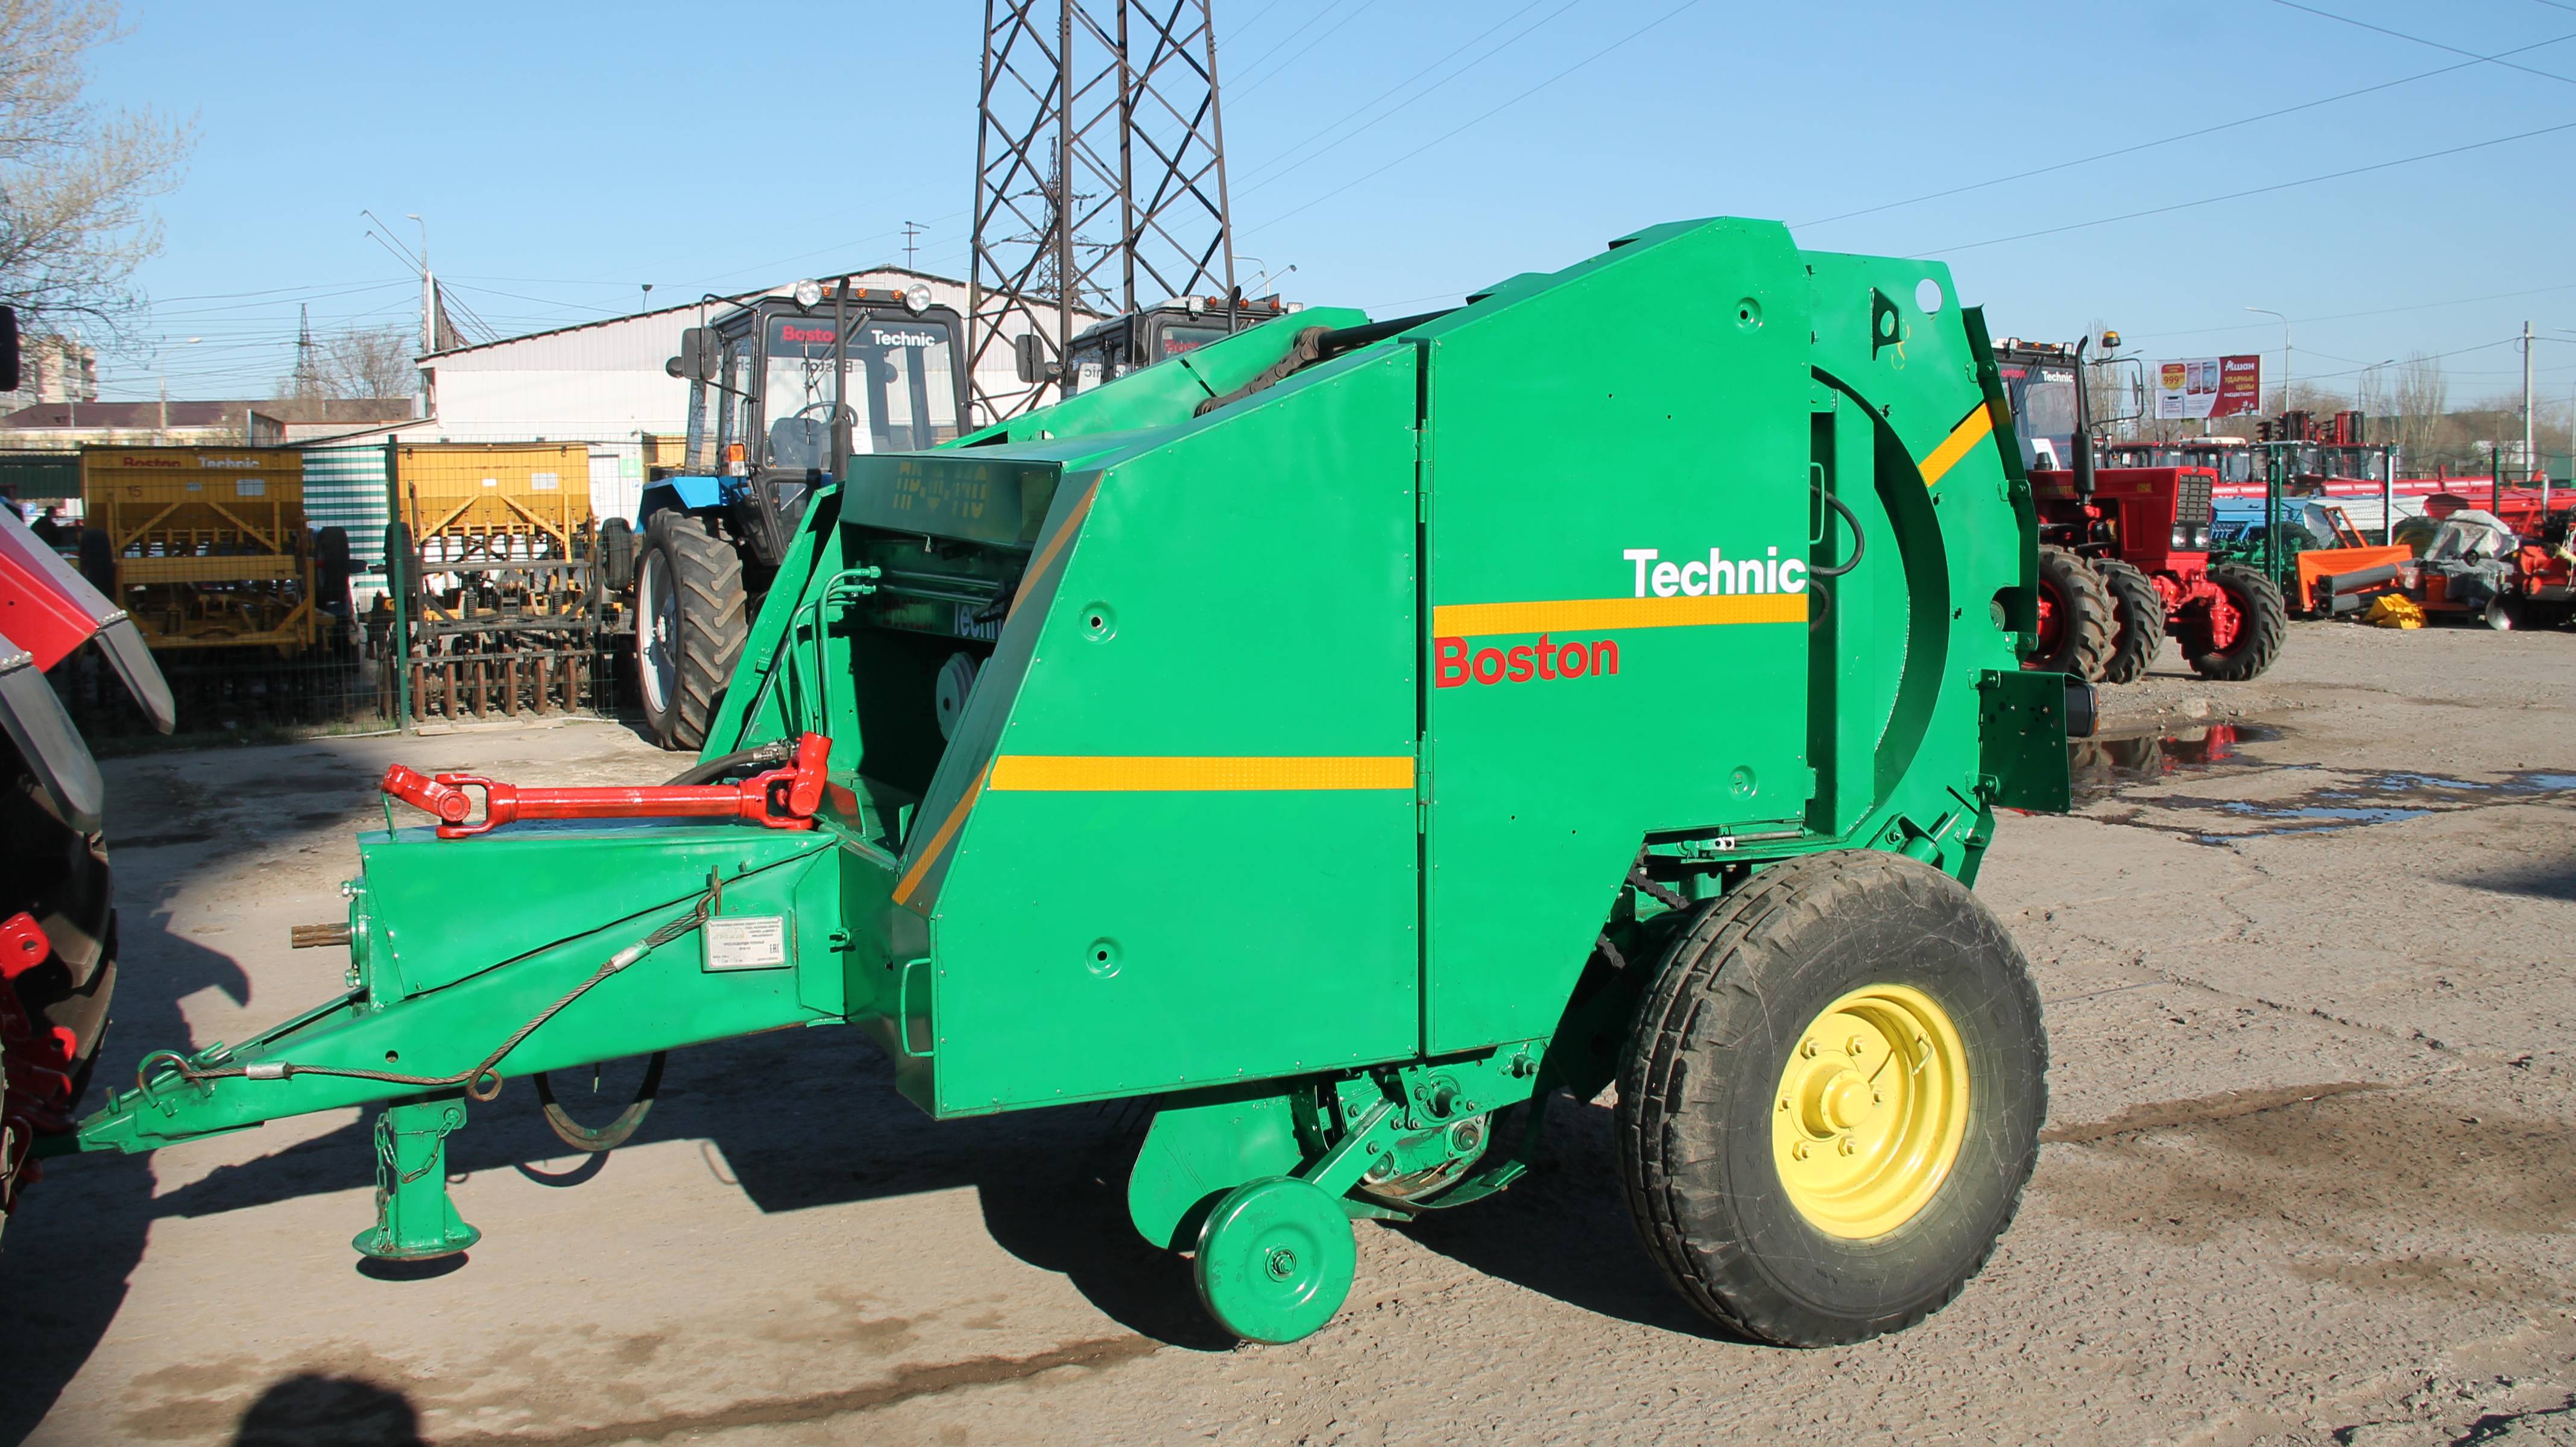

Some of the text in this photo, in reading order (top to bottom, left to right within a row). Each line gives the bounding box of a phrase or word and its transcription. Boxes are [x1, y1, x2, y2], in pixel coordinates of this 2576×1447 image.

[782, 326, 935, 347] Bosto Technic
[1164, 338, 1200, 353] Bost
[2225, 361, 2255, 371] Ашан
[2000, 369, 2074, 383] oston Technic
[1623, 546, 1807, 597] Technic
[1434, 632, 1619, 689] Boston
